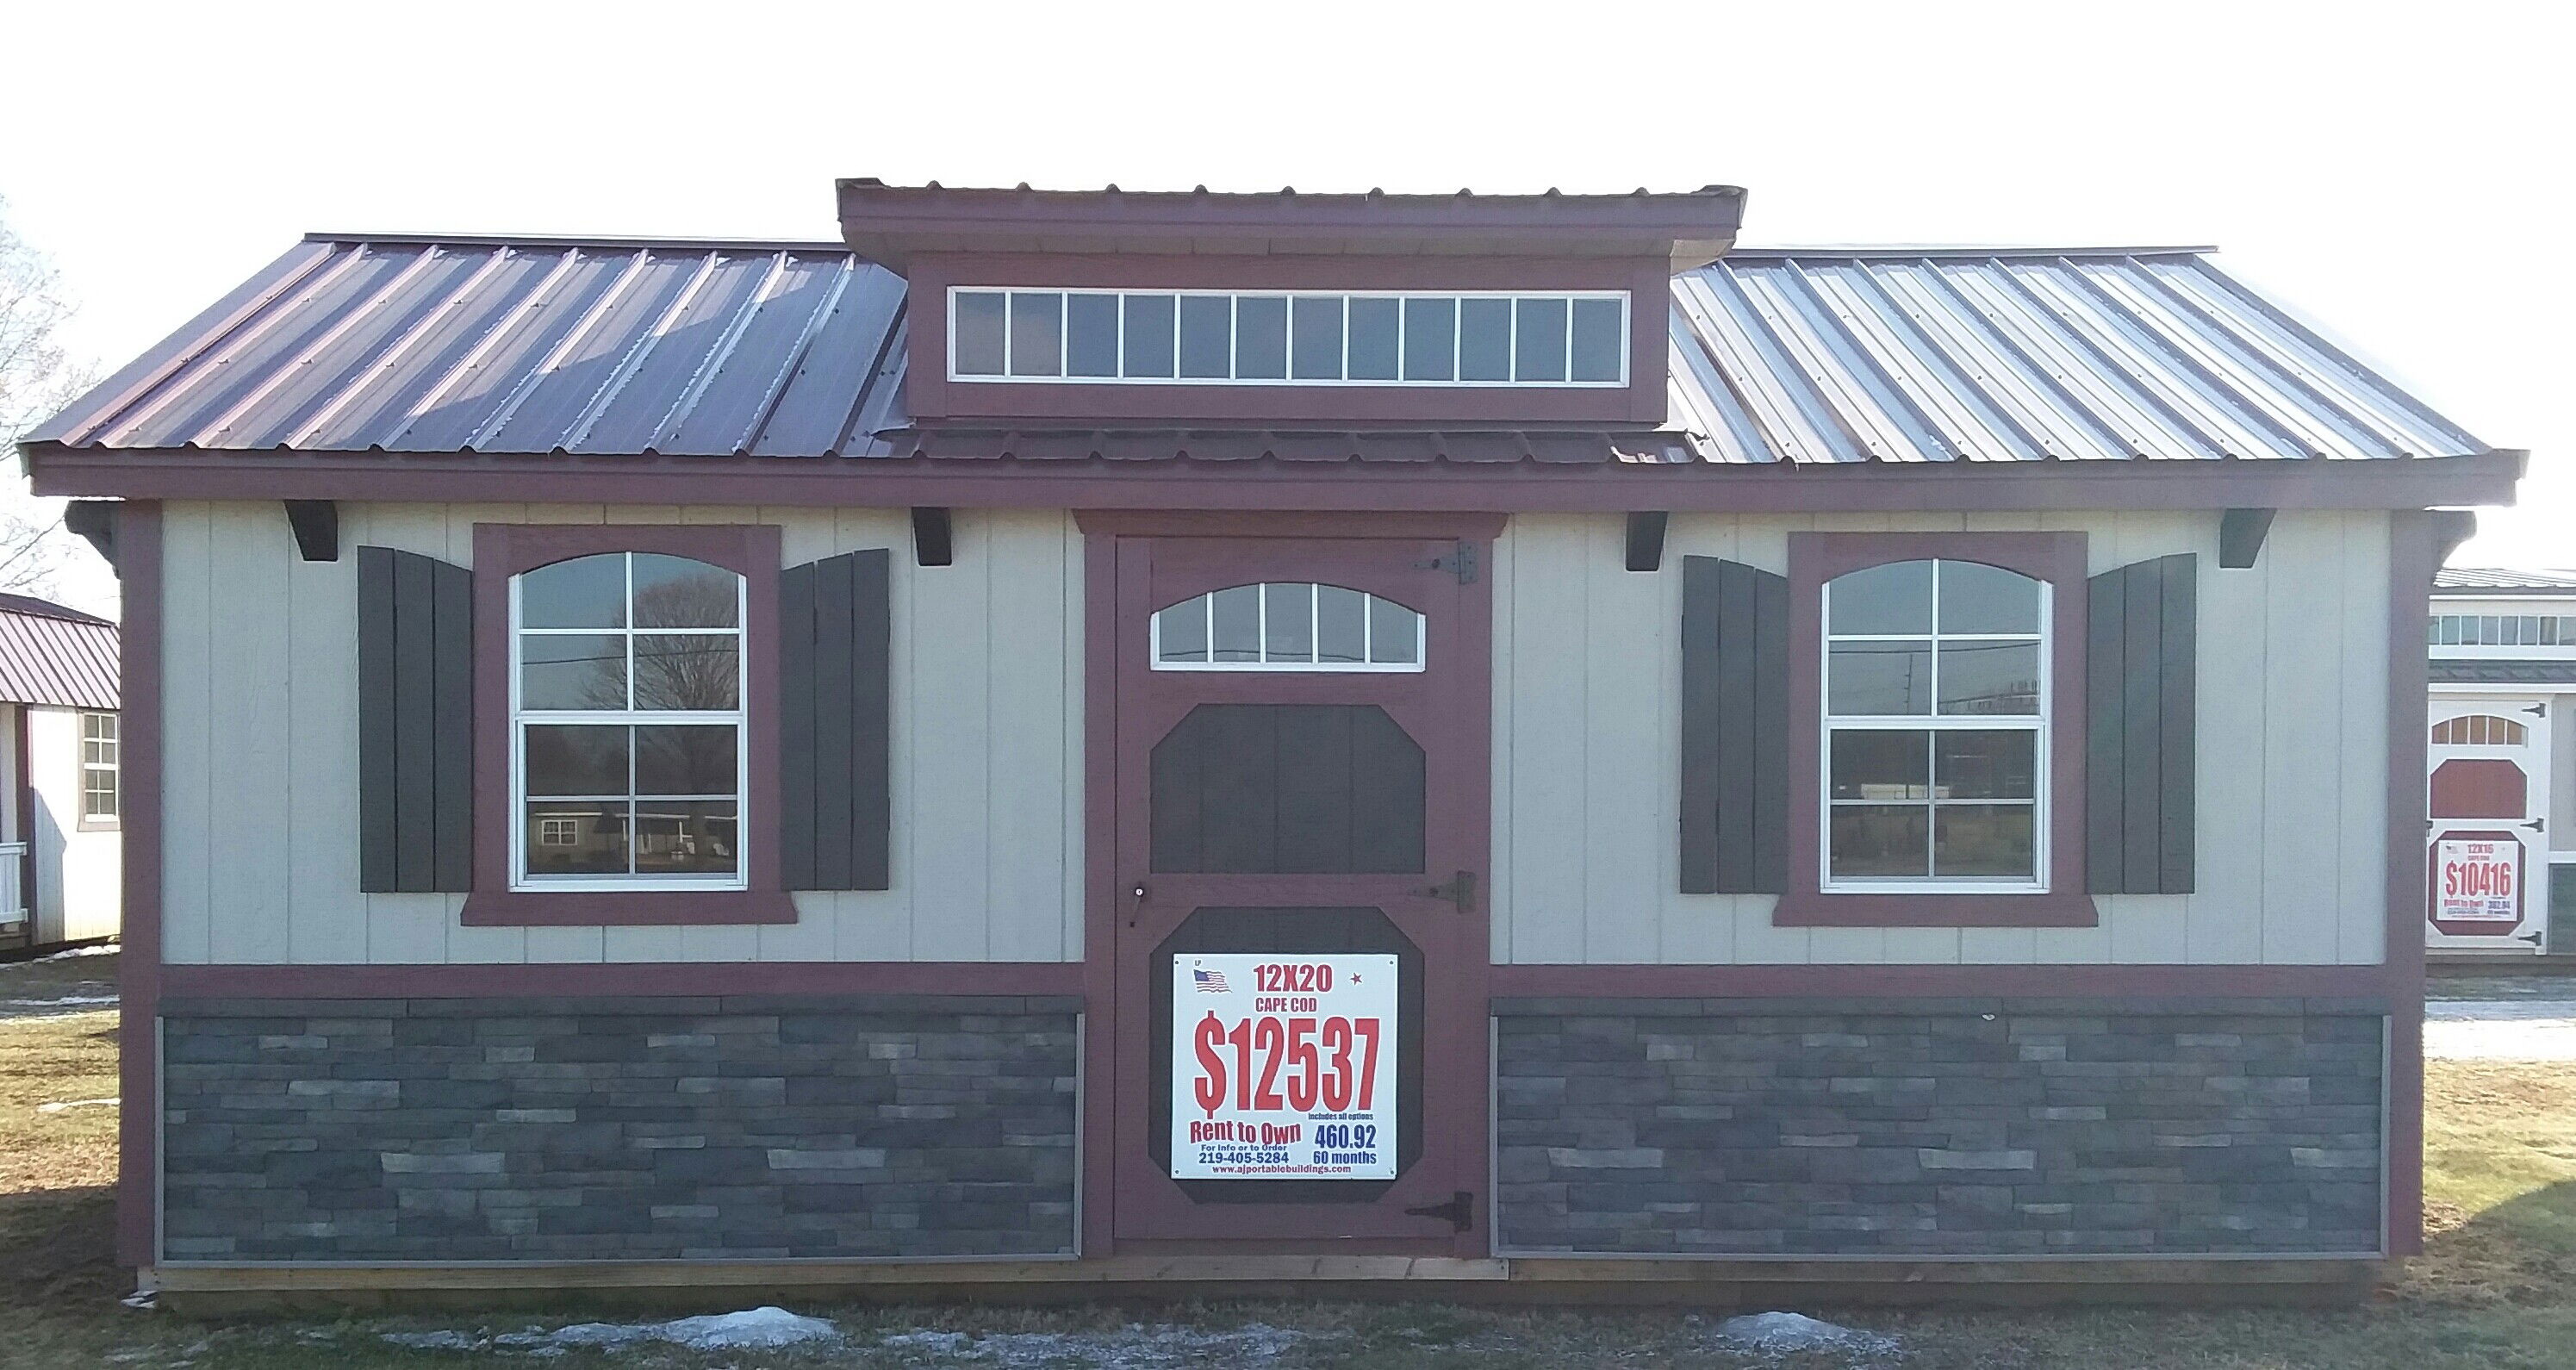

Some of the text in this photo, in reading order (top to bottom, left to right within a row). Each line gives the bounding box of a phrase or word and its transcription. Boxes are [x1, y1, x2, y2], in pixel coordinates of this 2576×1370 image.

[2445, 860, 2511, 898] $10416
[1254, 964, 1333, 992] 12X20
[1255, 998, 1317, 1012] CAPE COD
[1194, 1010, 1380, 1119] $12537
[1190, 1121, 1301, 1144] Rent to Own
[1315, 1124, 1377, 1149] 460.92
[1198, 1152, 1289, 1164] 219-405-5284
[1313, 1151, 1377, 1164] 60 months
[1212, 1165, 1351, 1174] www.ajportablebuildings.com
